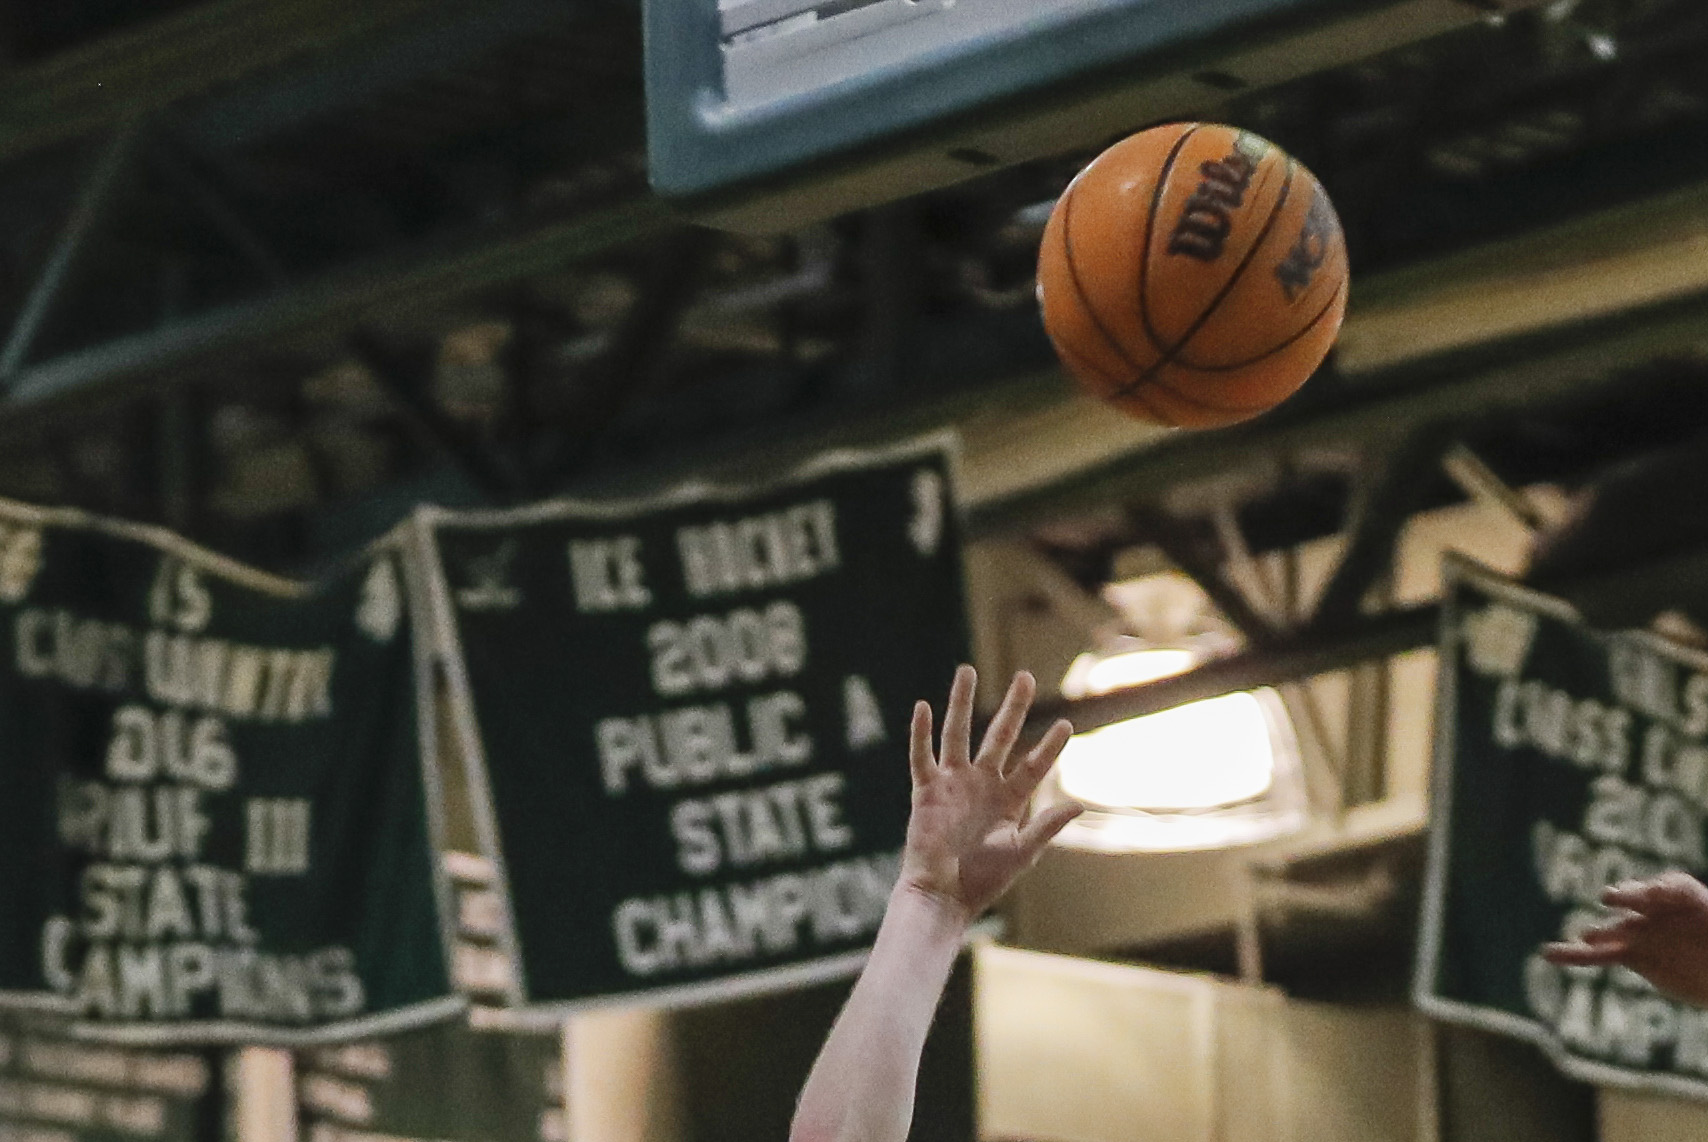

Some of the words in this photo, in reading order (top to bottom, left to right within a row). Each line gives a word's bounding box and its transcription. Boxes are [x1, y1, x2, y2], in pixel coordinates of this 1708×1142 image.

[596, 691, 814, 796] PUBLIC
[669, 770, 855, 878] STATE
[80, 863, 260, 947] STATE
[611, 845, 906, 980] CHAMPION
[40, 913, 366, 1020] CAMPIONS
